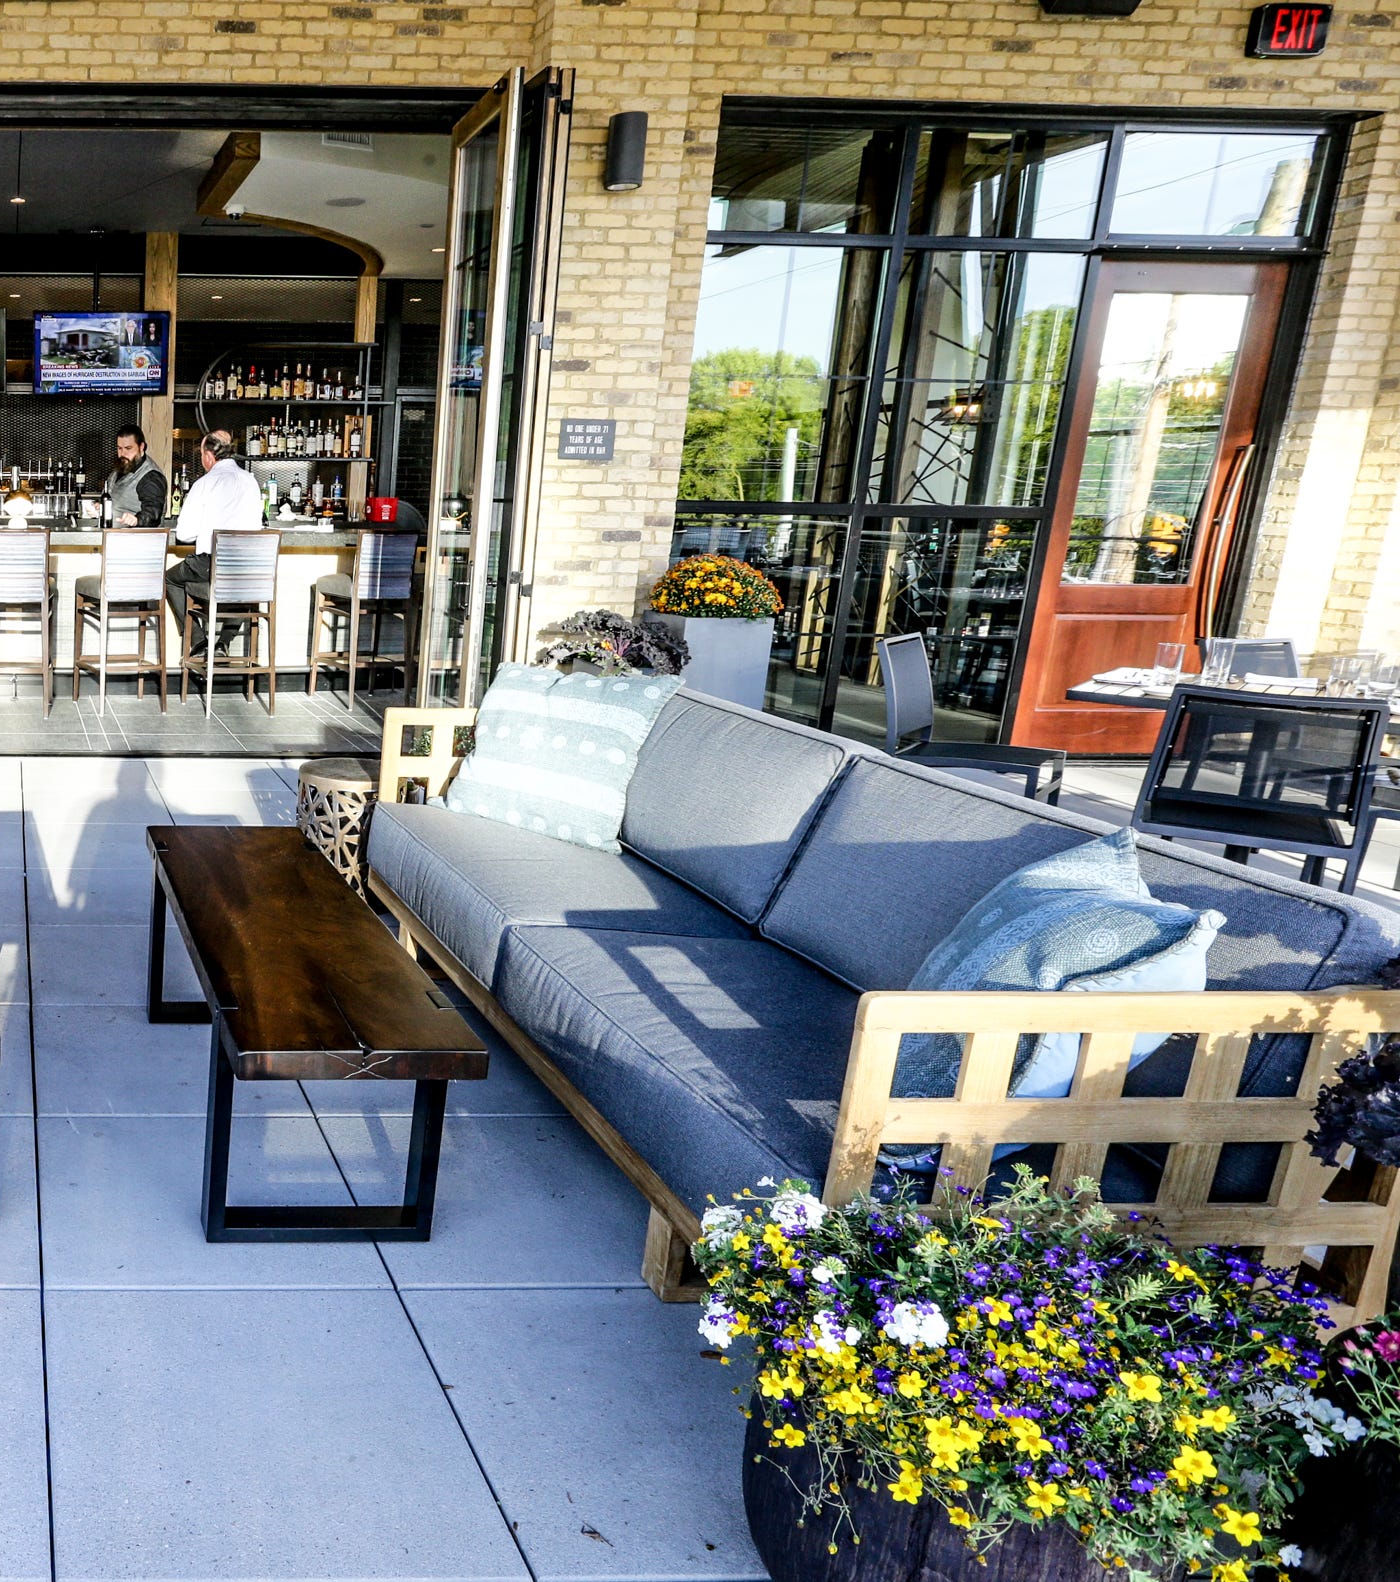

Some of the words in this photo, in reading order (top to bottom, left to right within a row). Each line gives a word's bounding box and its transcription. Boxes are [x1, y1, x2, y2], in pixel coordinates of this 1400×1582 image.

[1270, 9, 1323, 49] EXIT
[567, 424, 573, 432] NO
[575, 424, 585, 433] ONE
[586, 425, 601, 433] UNDER
[603, 425, 609, 433] 21
[569, 435, 584, 443] YEARS
[586, 435, 593, 443] OF
[594, 436, 604, 444] AGE
[564, 446, 587, 454] ADMITTED
[588, 446, 595, 454] IN
[596, 446, 606, 454] BAR
